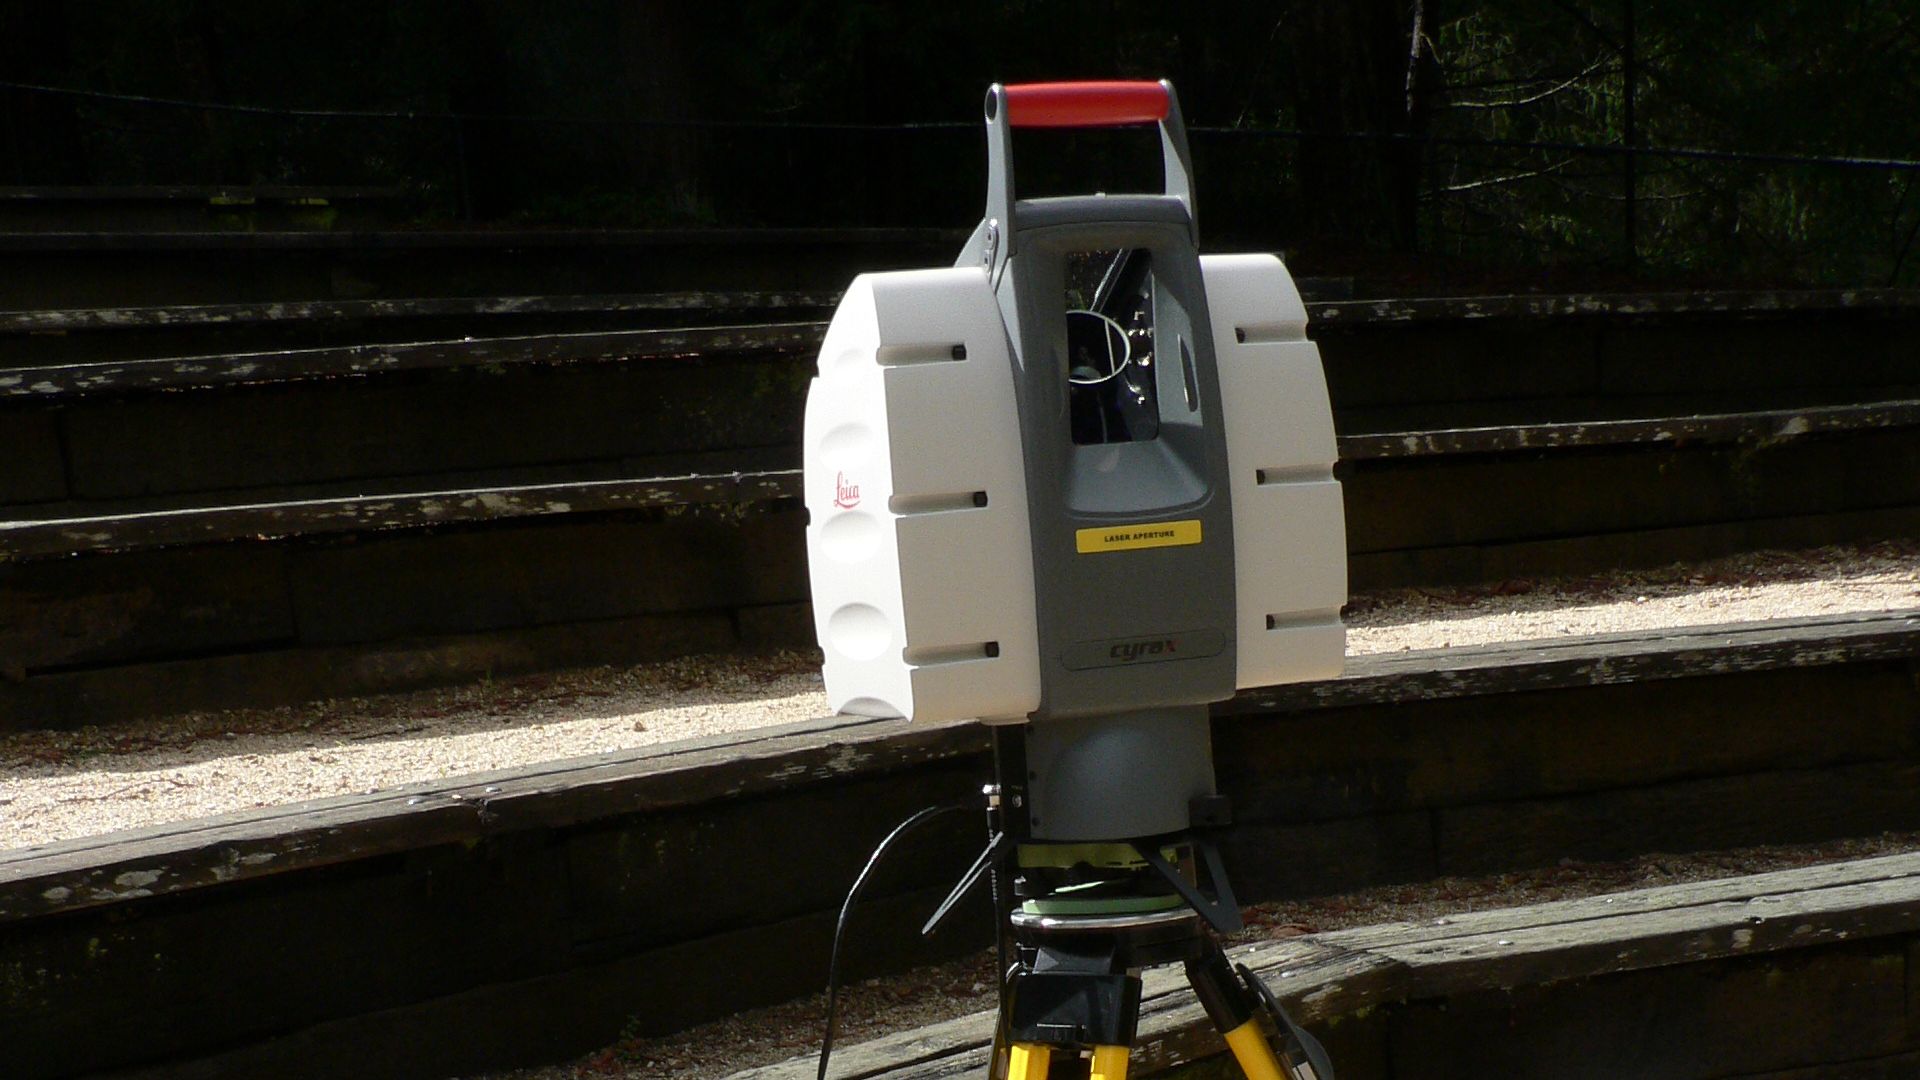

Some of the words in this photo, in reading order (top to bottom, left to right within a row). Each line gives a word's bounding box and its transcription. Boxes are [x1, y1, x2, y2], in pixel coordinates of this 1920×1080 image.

[833, 471, 861, 509] Leica
[1104, 533, 1131, 543] LASER
[1133, 530, 1175, 541] APERTURE
[1110, 639, 1176, 661] cyrax
